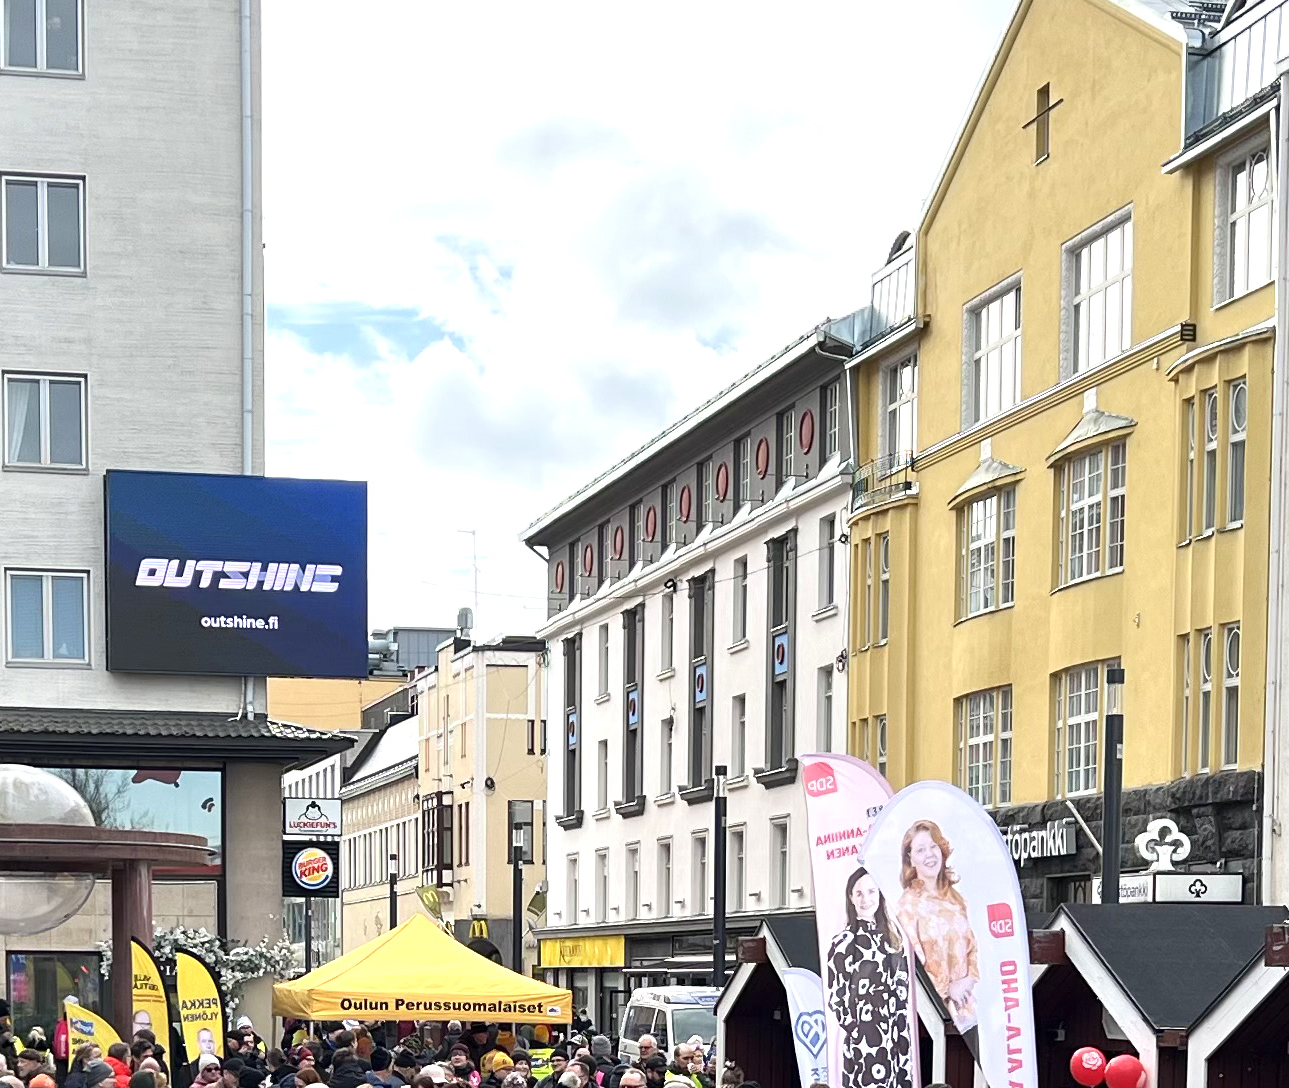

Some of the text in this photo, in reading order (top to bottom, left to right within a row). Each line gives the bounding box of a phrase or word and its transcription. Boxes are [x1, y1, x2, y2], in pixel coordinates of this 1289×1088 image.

[135, 558, 343, 593] OUTSHINE
[201, 615, 279, 630] outshine.fi
[1004, 825, 1067, 868] töpankki
[297, 856, 328, 871] BURGER
[299, 863, 329, 880] KING
[340, 998, 544, 1015] Oulun Perussuomalaiset
